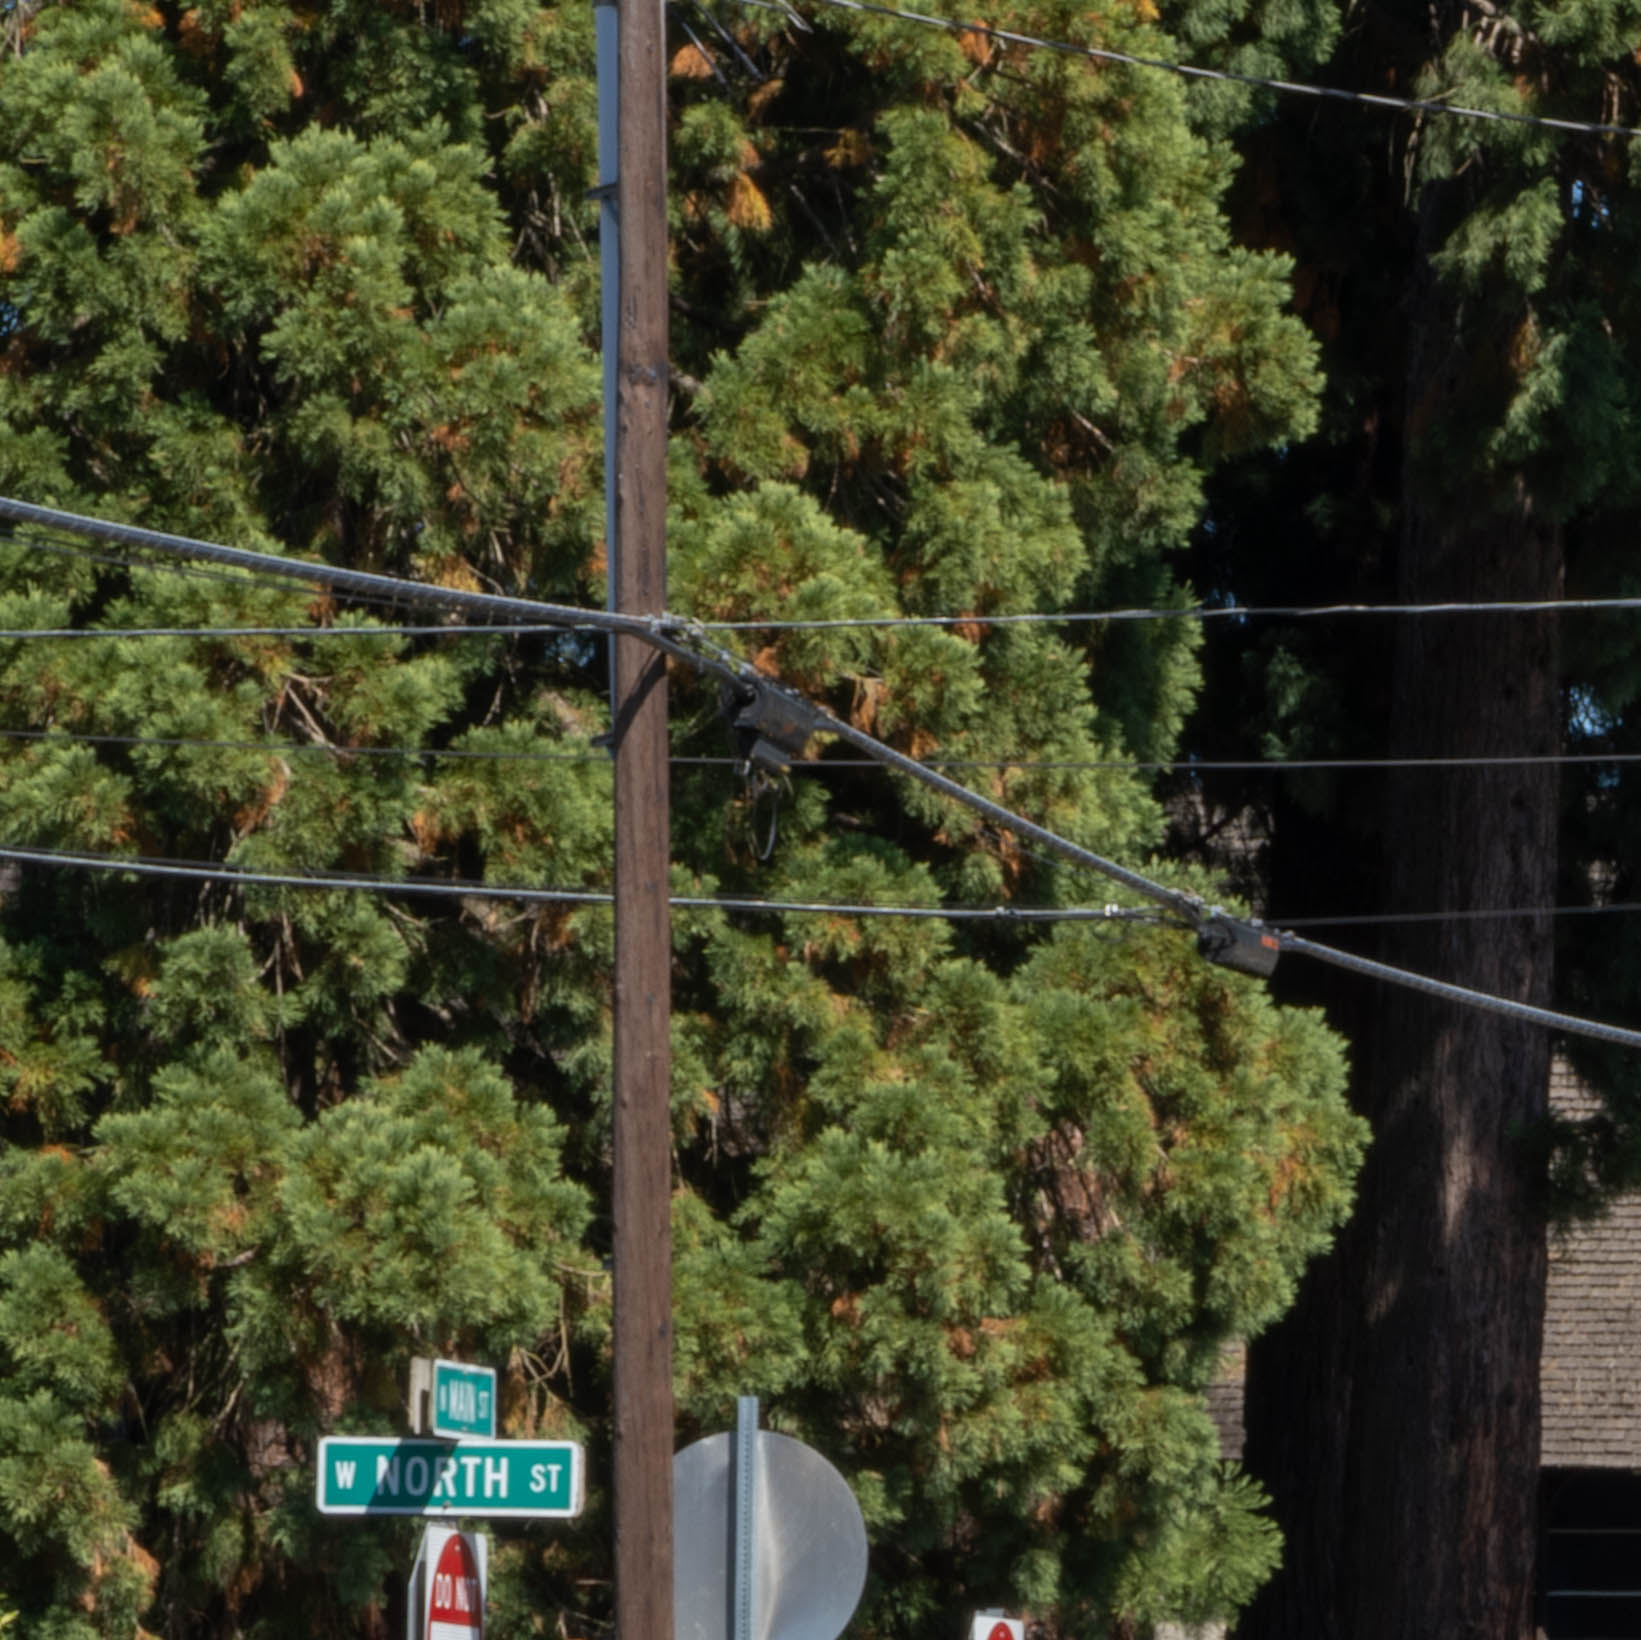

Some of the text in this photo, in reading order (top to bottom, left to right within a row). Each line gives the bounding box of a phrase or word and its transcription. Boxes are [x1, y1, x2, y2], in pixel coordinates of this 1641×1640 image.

[335, 1454, 562, 1499] W NORTH ST
[435, 1573, 477, 1613] DO NOT
